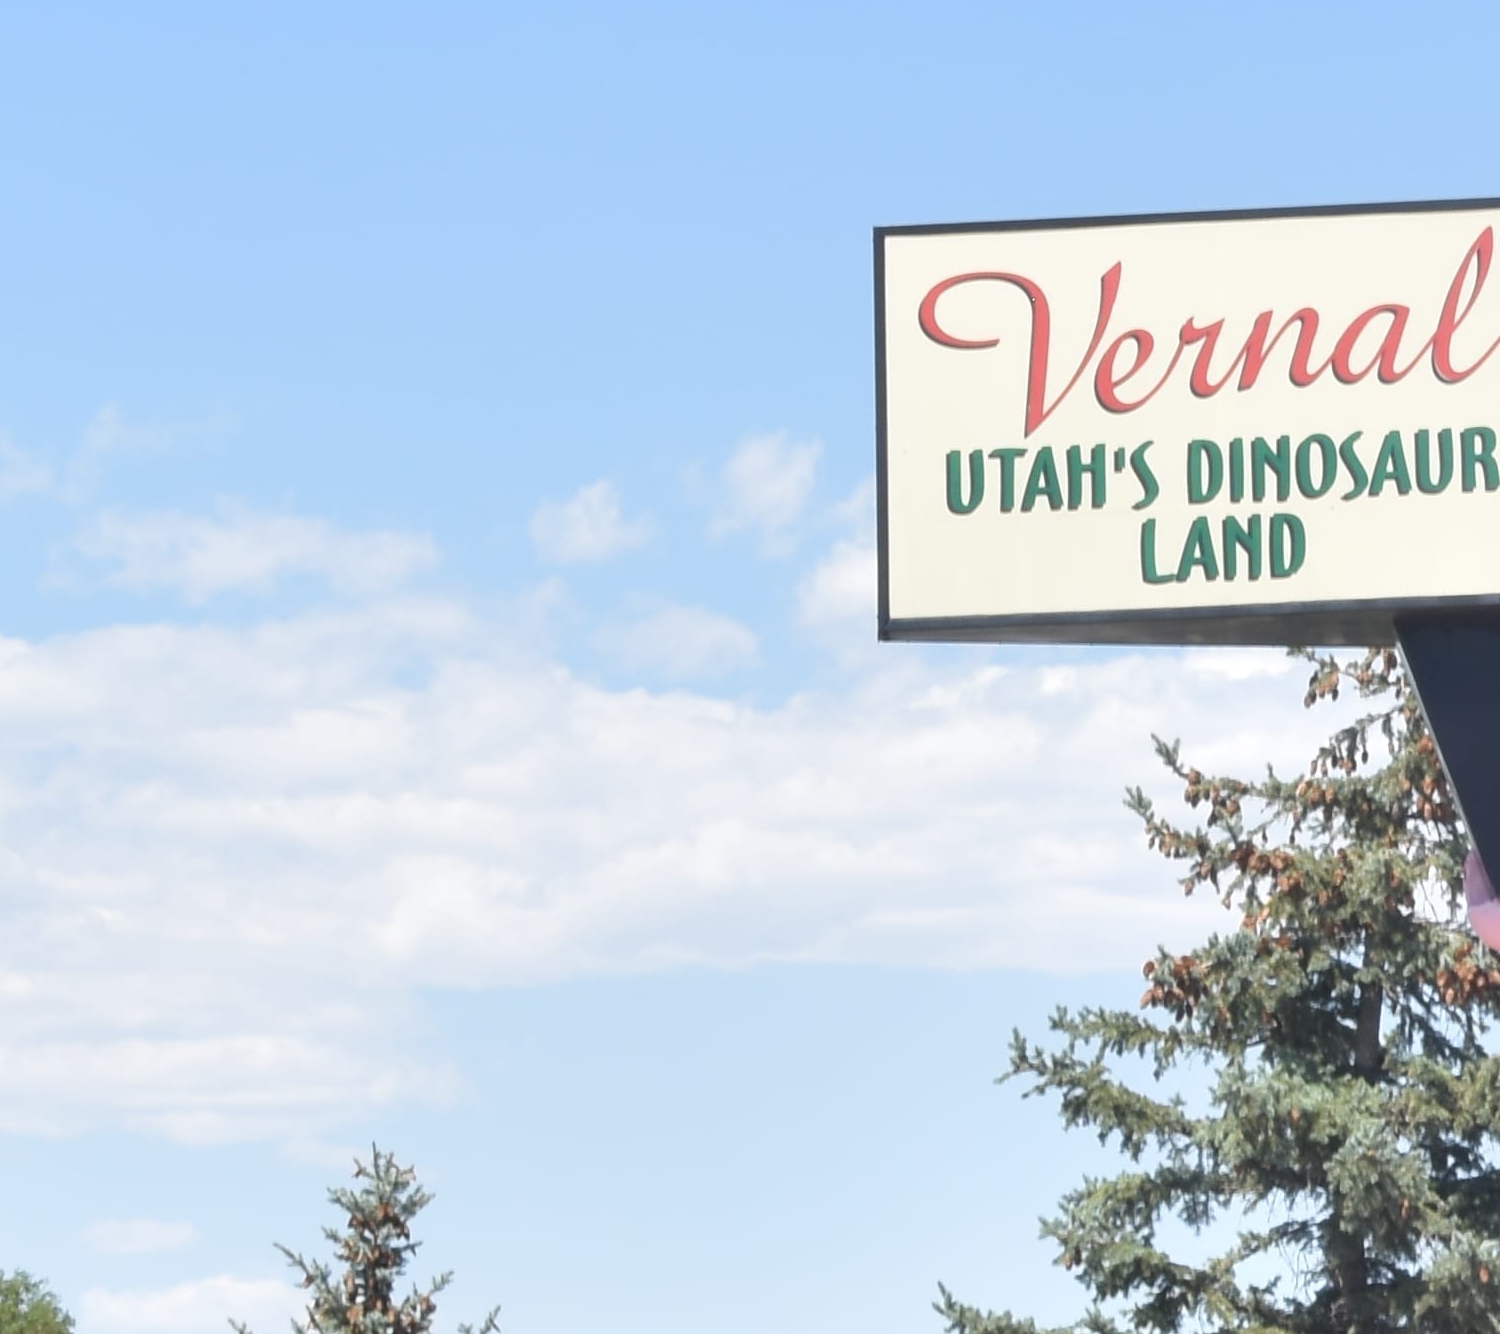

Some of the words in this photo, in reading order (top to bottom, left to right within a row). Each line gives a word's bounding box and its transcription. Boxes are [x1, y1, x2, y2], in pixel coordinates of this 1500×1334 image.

[946, 440, 1160, 514] UTAH'S
[1187, 426, 1500, 504] DINOSAUR
[1140, 513, 1307, 584] LAND
